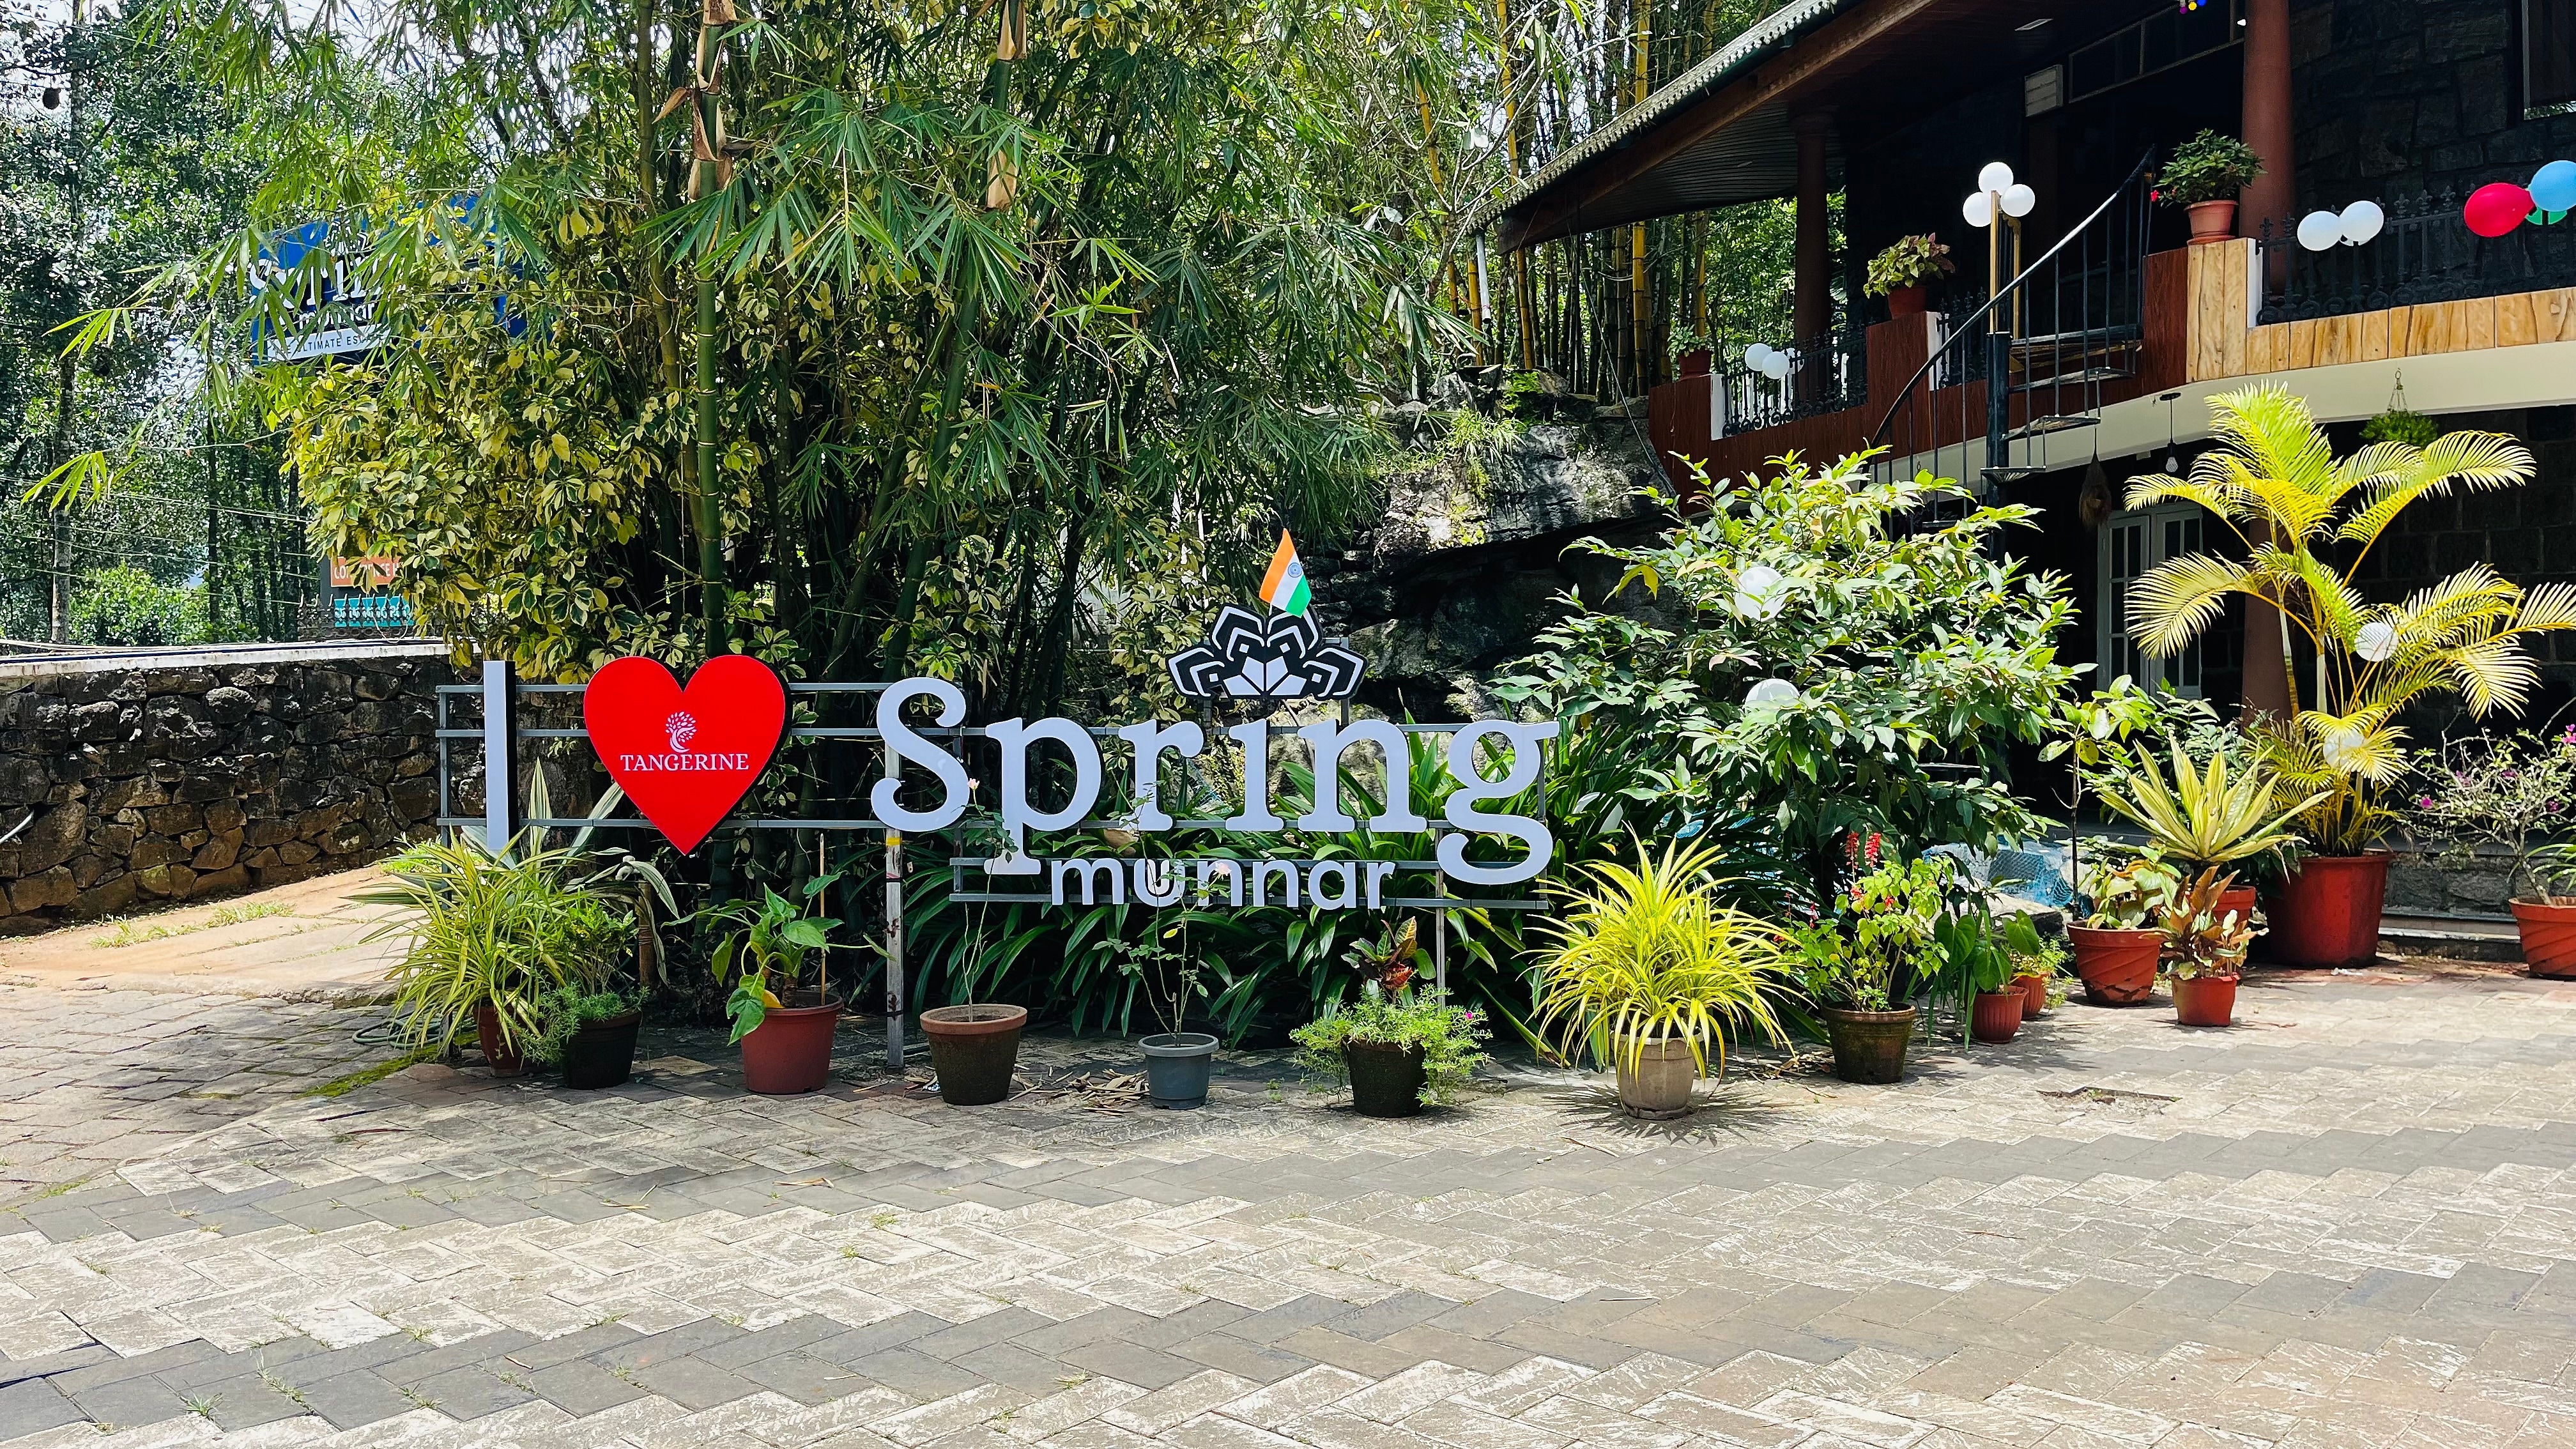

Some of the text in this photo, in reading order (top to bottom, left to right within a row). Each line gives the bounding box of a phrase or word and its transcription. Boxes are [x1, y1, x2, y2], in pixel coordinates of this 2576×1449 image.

[296, 337, 342, 353] LTIMATE
[483, 660, 1560, 884] I Spring
[620, 753, 749, 771] TANGERINE
[1051, 858, 1395, 910] munnar
